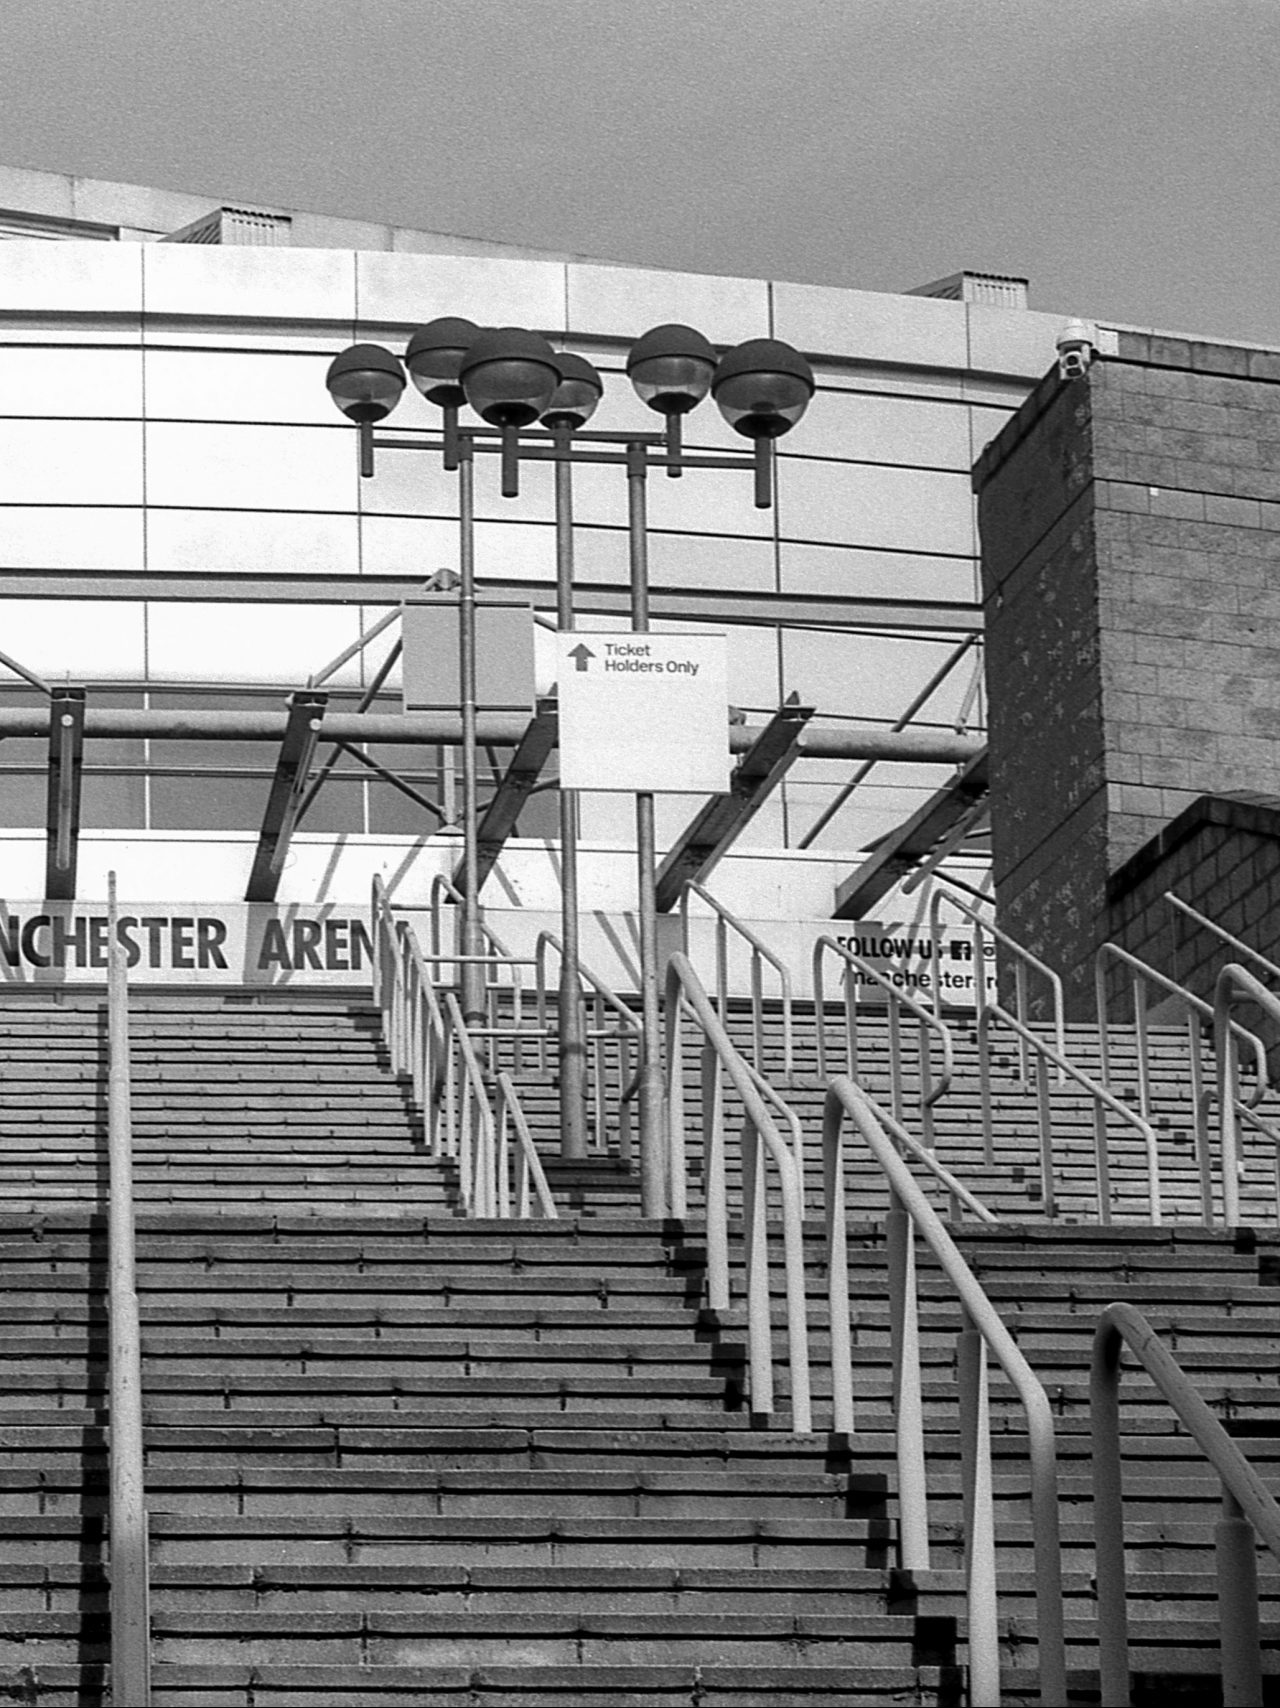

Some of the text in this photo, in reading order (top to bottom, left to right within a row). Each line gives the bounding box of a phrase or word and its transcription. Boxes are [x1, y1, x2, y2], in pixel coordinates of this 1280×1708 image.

[604, 643, 651, 656] Ticket
[605, 660, 699, 676] Holders Only
[837, 936, 914, 959] FOLLOW
